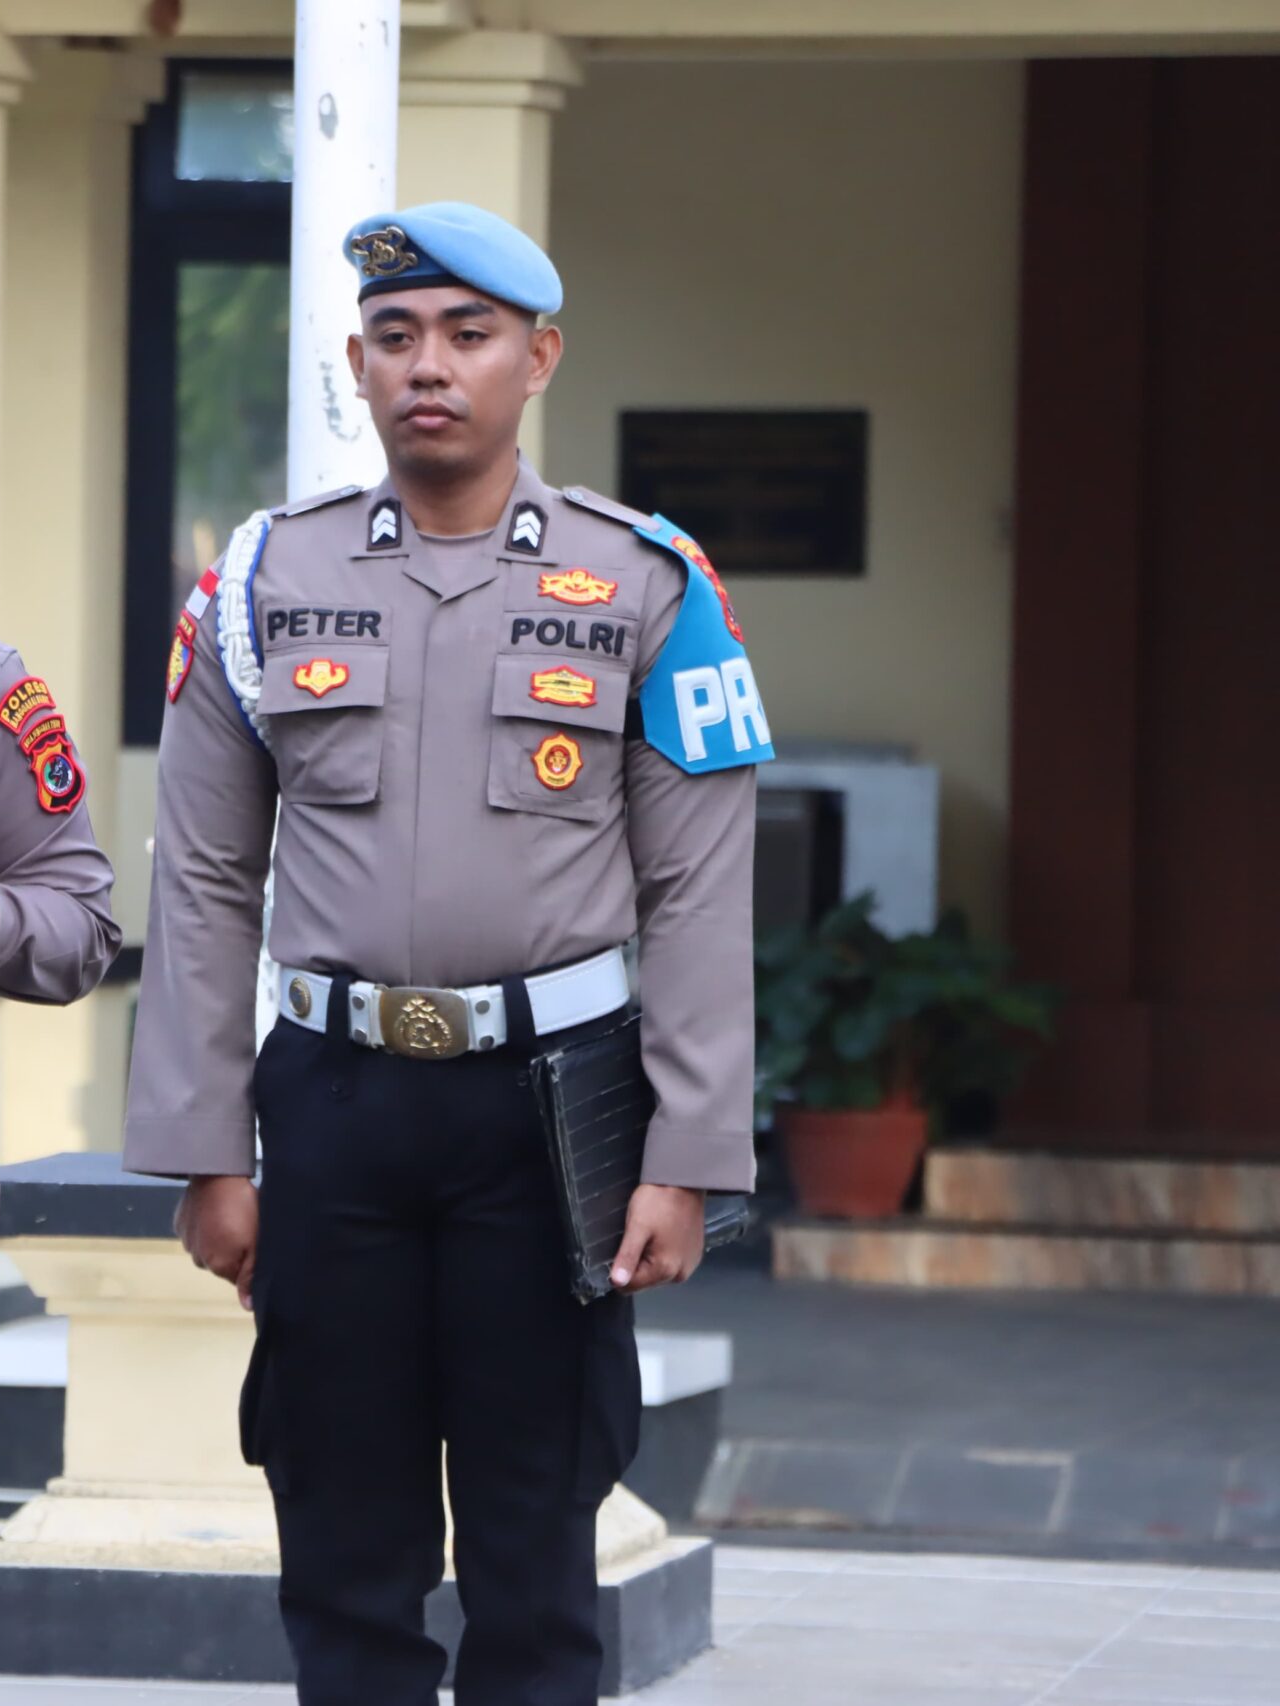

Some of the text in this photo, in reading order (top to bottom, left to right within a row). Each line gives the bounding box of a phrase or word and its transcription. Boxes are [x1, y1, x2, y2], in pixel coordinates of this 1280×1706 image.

[267, 607, 382, 642] PETER
[511, 617, 625, 657] POLRI
[672, 657, 771, 762] PR
